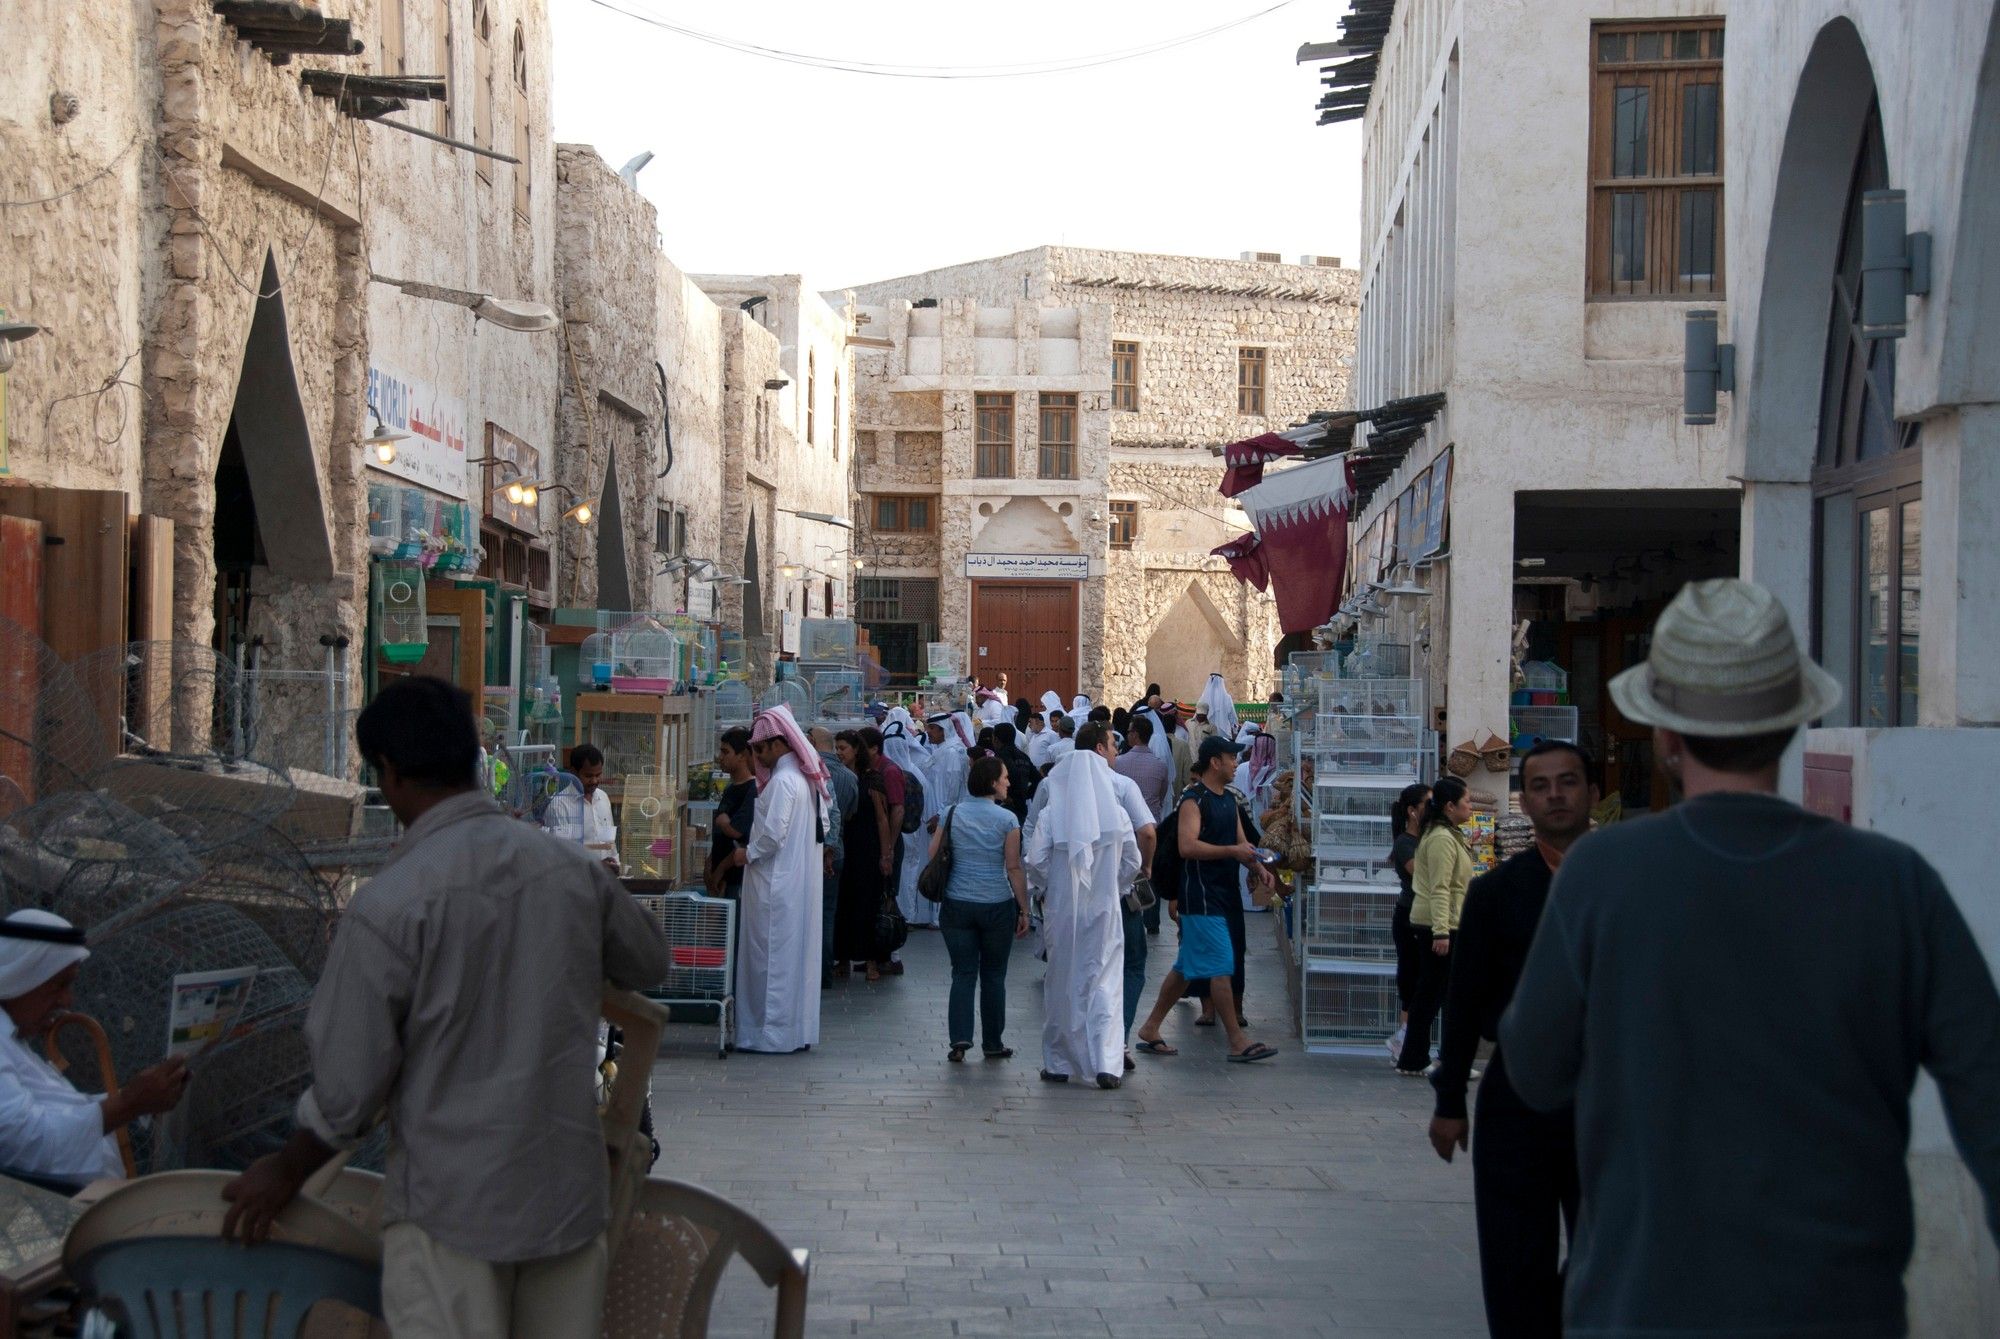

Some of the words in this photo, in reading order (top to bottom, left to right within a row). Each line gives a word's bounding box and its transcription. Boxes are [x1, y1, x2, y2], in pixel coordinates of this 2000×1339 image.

[380, 371, 407, 430] WORLD
[997, 558, 1018, 566] محمد
[1037, 559, 1059, 567] محمد
[1059, 557, 1087, 568] مؤسسة
